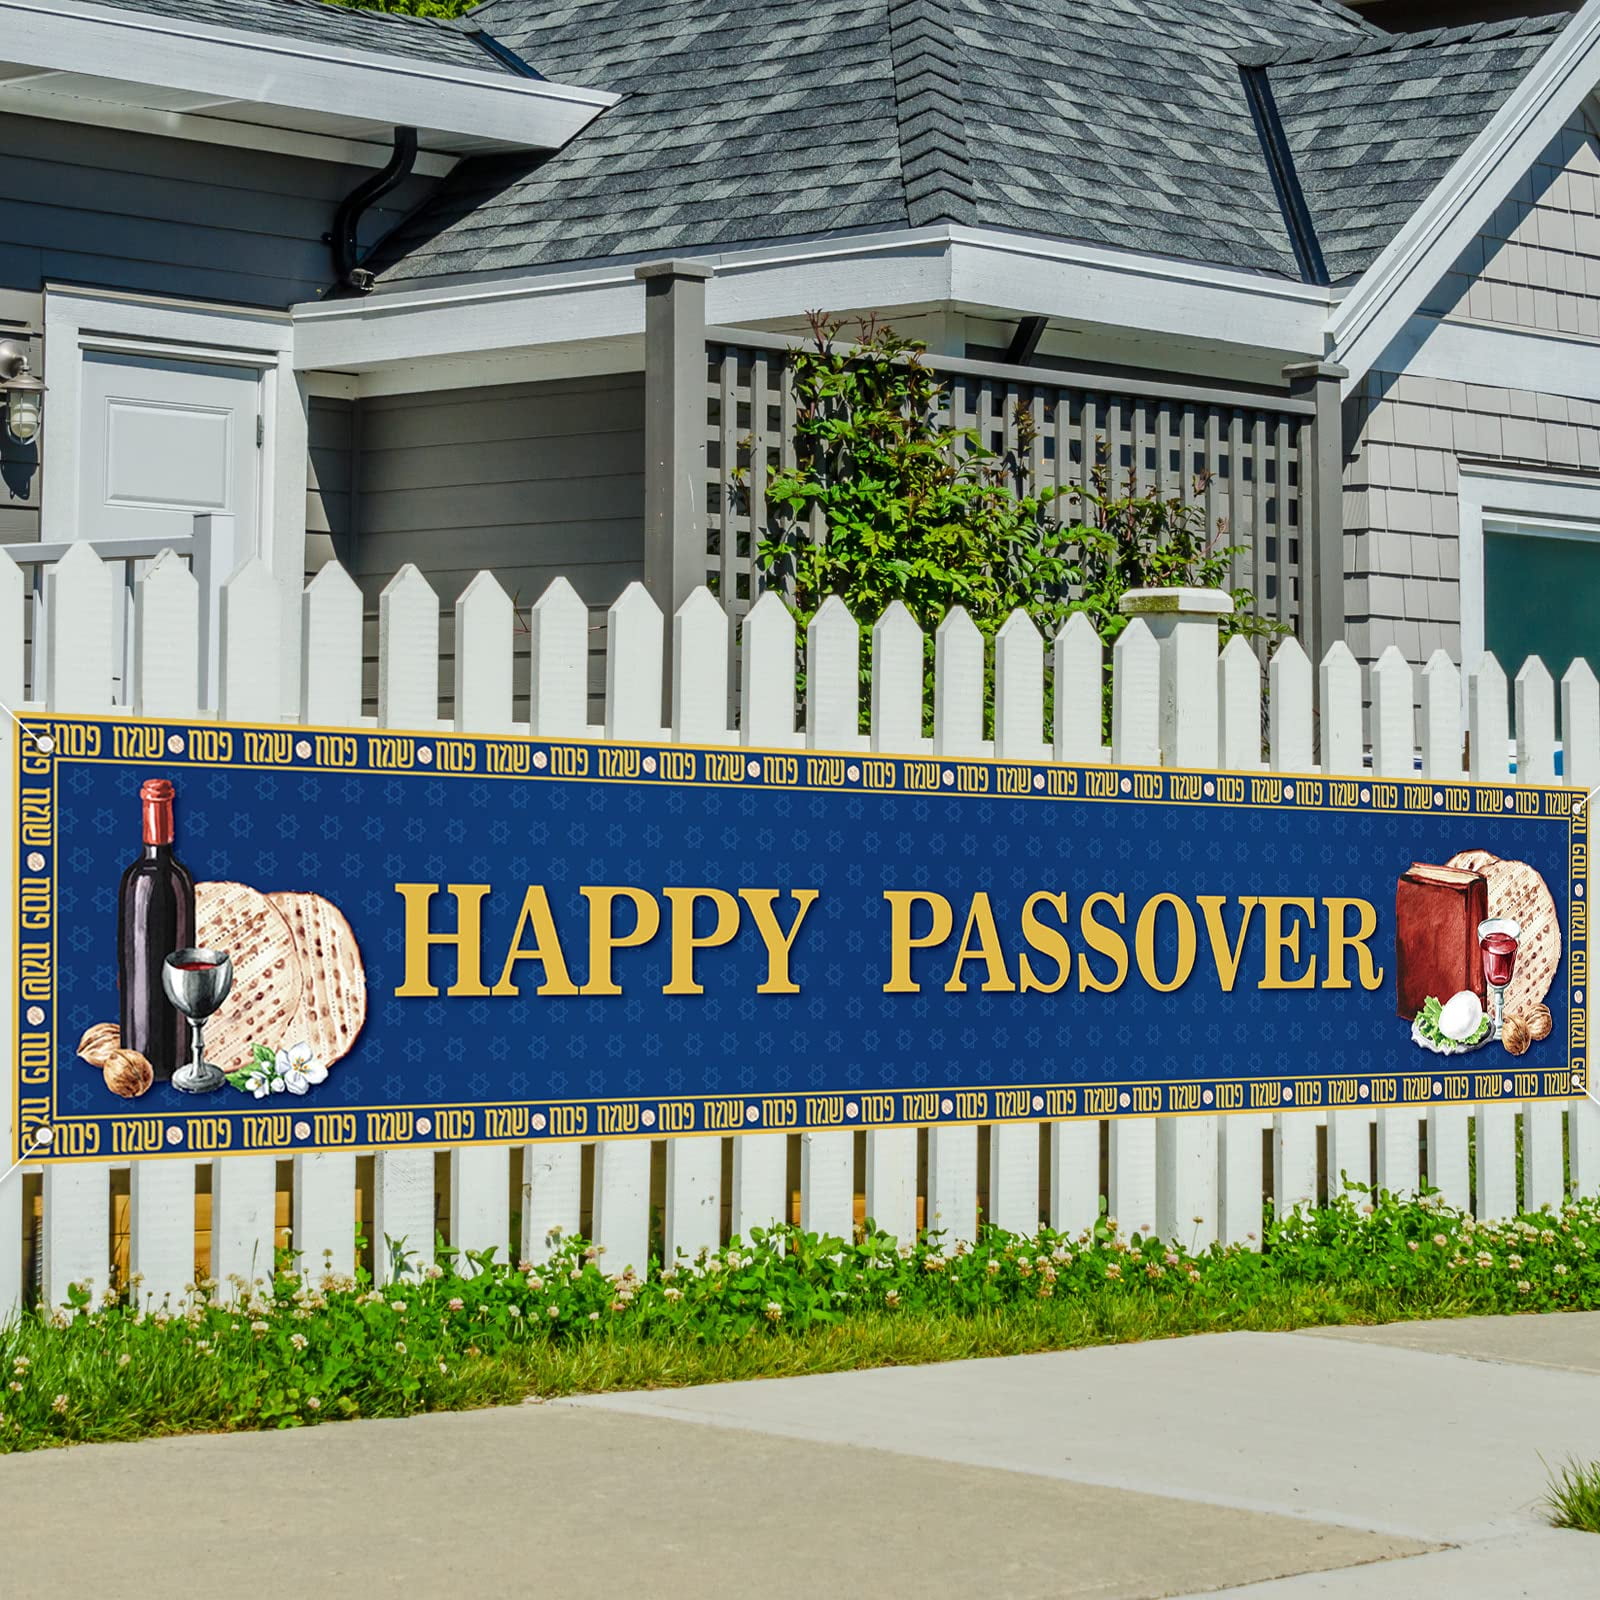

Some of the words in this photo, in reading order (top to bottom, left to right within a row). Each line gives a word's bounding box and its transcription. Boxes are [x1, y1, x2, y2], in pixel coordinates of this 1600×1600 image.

[113, 726, 164, 758] שמח
[188, 729, 232, 761] פסח
[244, 732, 292, 763] שמח
[316, 735, 357, 766] פסח
[368, 738, 414, 768] שמח
[436, 741, 475, 770] פסח
[486, 743, 529, 772] שמח
[551, 746, 588, 775] פסח
[598, 748, 640, 777] שמח
[660, 751, 695, 780] פסח
[706, 753, 744, 781] שמח
[764, 756, 798, 784] פסח
[808, 758, 844, 785] שמח
[863, 761, 895, 788] פסח
[904, 763, 940, 789] שמח
[957, 765, 988, 791] פסח
[997, 767, 1031, 792] שמח
[1048, 769, 1077, 795] פסח
[1086, 771, 1118, 796] שמח
[1134, 773, 1162, 798] פסח
[1170, 775, 1201, 800] שמח
[1217, 777, 1244, 802] פסח
[1252, 779, 1282, 802] שמח
[1296, 781, 1322, 805] פסח
[1330, 783, 1358, 806] שמח
[1373, 784, 1397, 808] פסח
[1404, 786, 1432, 808] שמח
[1446, 788, 1469, 810] פסח
[1476, 789, 1503, 812] שמח
[1516, 791, 1538, 814] פסח
[1546, 792, 1571, 814] שמח
[22, 788, 51, 846] שמח
[1572, 843, 1586, 879] פסח
[21, 877, 51, 929] פסח
[1572, 900, 1586, 941] שמח
[394, 883, 819, 997] HAPPY
[883, 890, 1384, 993] PASSOVER
[21, 942, 51, 1001] שמח
[1572, 950, 1586, 986] פסח
[1571, 1007, 1585, 1049] שמח
[21, 1033, 50, 1084] פסח
[1216, 1083, 1242, 1107] פסח
[1250, 1082, 1280, 1106] שמח
[1296, 1081, 1321, 1104] פסח
[1328, 1079, 1357, 1103] שמח
[1372, 1078, 1396, 1101] פסח
[1404, 1077, 1431, 1100] שמח
[1445, 1076, 1468, 1098] פסח
[1476, 1075, 1503, 1097] שמח
[1515, 1073, 1538, 1096] פסח
[1544, 1072, 1570, 1094] שמח
[806, 1097, 843, 1124] שמח
[862, 1095, 894, 1122] פסח
[903, 1094, 938, 1120] שמח
[956, 1092, 987, 1118] פסח
[996, 1091, 1030, 1116] שמח
[1046, 1089, 1076, 1114] פסח
[1085, 1087, 1117, 1112] שמח
[1134, 1087, 1161, 1110] פסח
[1169, 1085, 1200, 1109] שמח
[435, 1110, 474, 1139] פסח
[485, 1107, 528, 1136] שמח
[550, 1106, 587, 1134] פסח
[598, 1103, 638, 1132] שמח
[659, 1102, 694, 1130] פסח
[704, 1100, 743, 1128] שמח
[763, 1099, 796, 1125] פסח
[112, 1119, 163, 1152] שמח
[188, 1118, 231, 1149] פסח
[243, 1115, 291, 1146] שמח
[314, 1114, 356, 1144] פסח
[368, 1111, 413, 1141] שמח
